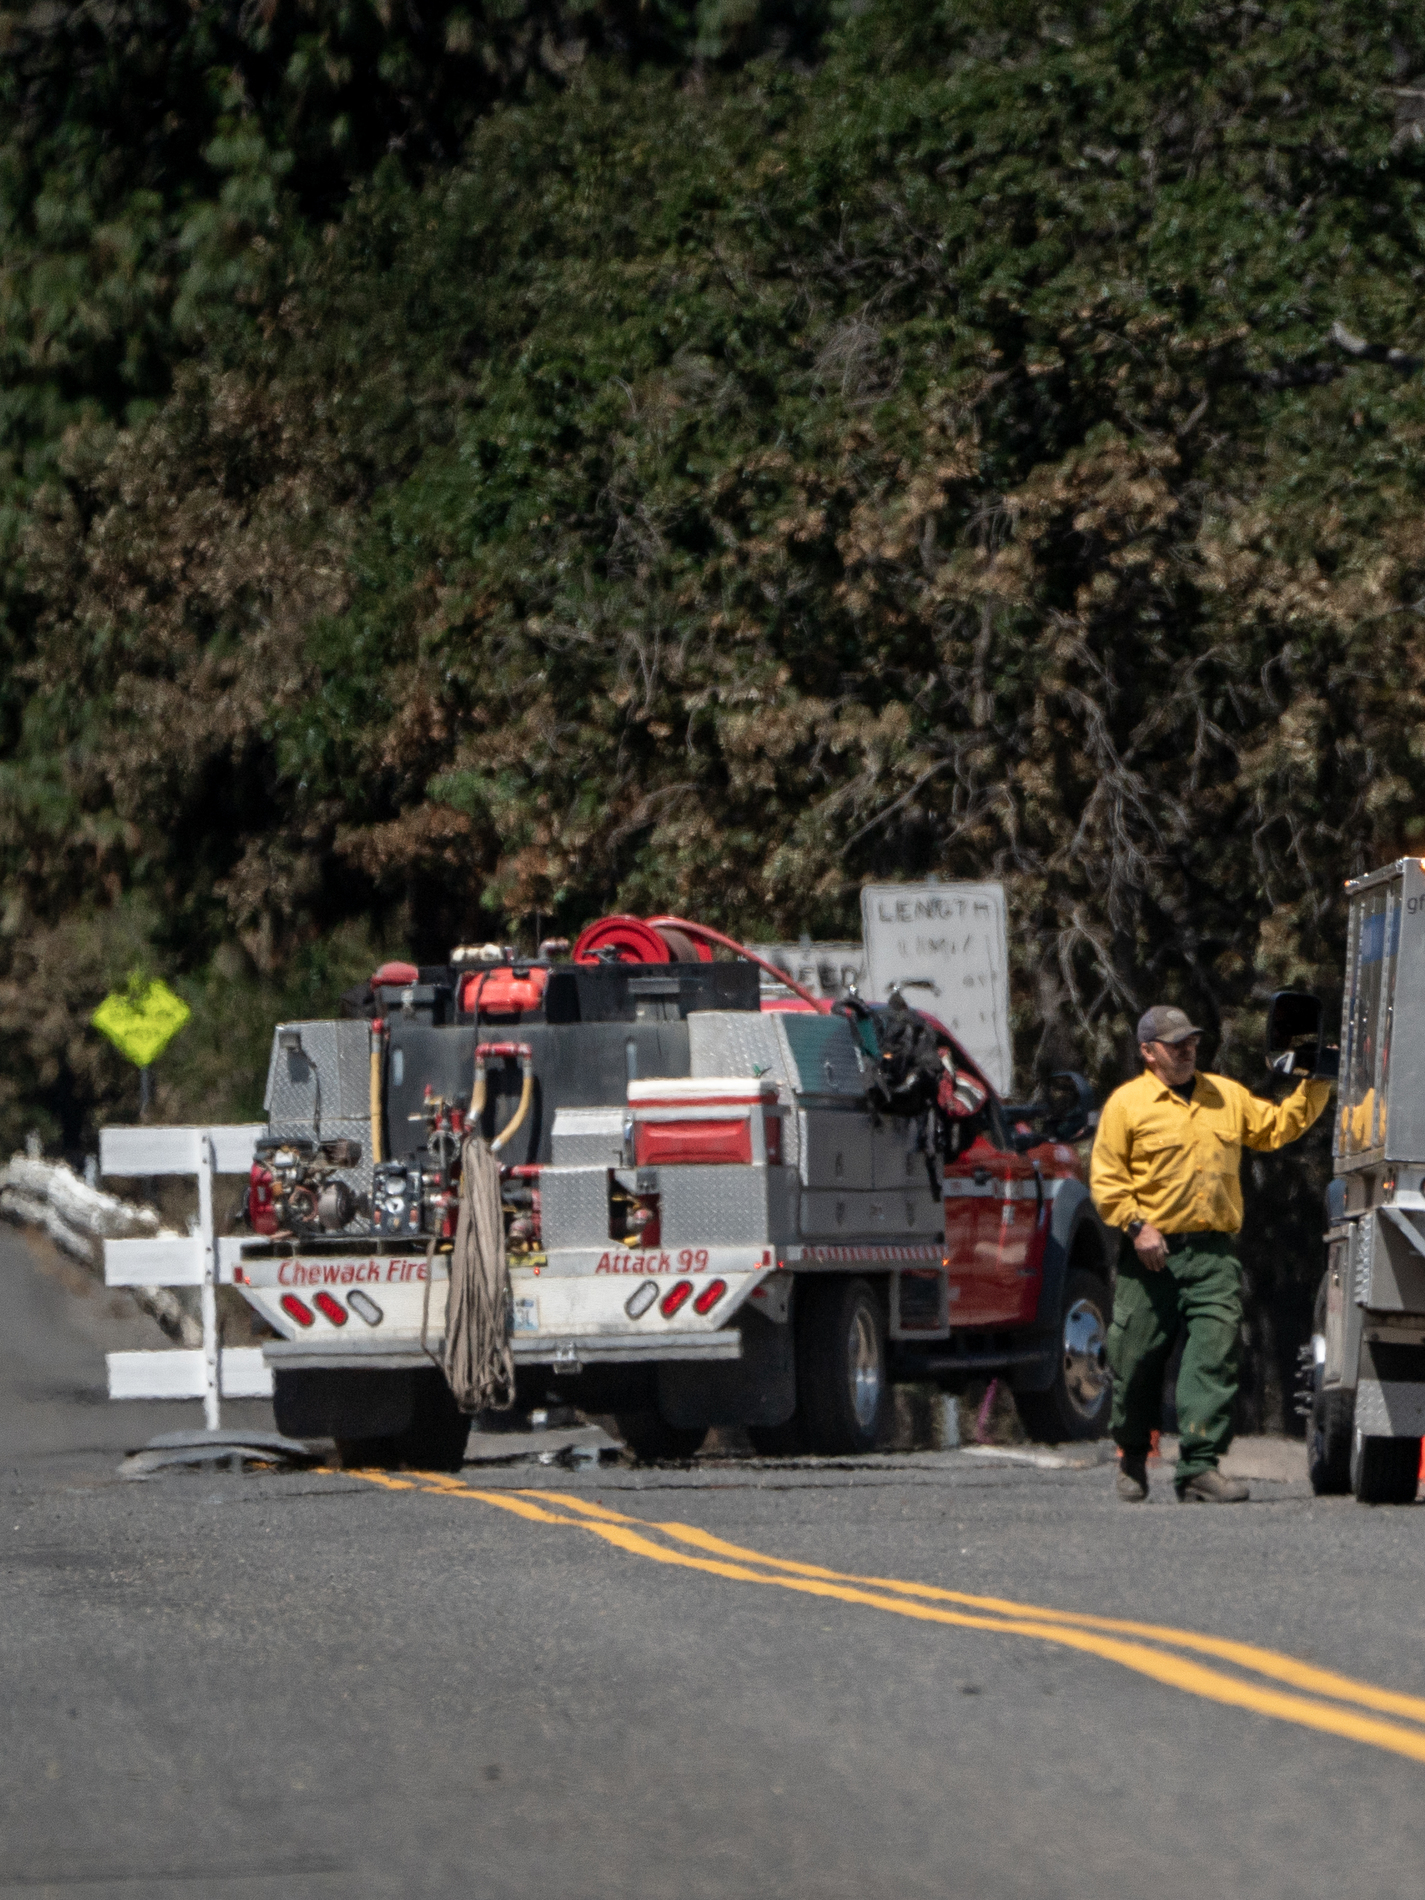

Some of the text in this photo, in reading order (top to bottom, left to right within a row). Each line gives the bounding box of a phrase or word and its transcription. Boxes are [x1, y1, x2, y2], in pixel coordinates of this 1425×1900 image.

[878, 900, 990, 924] LENGTH
[277, 1258, 428, 1287] Chewack Fire
[595, 1249, 709, 1274] Attack 99
